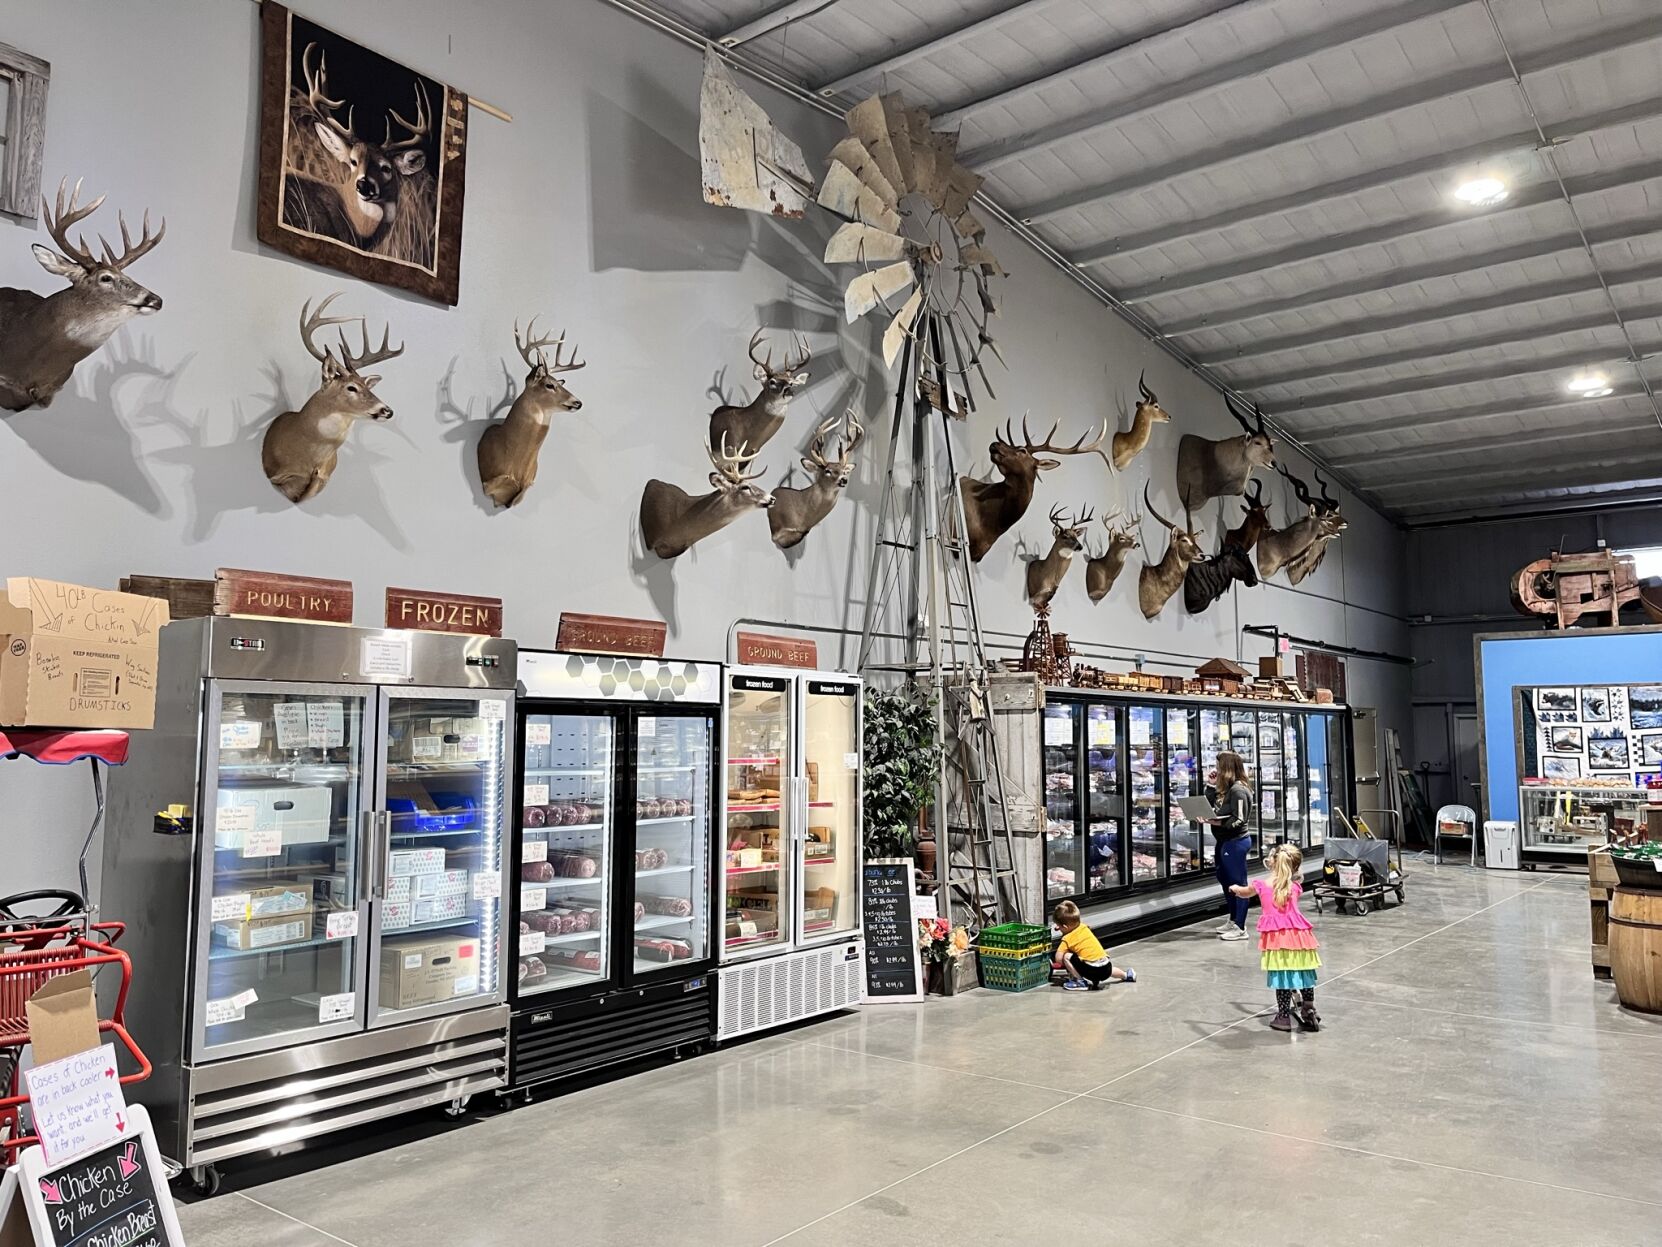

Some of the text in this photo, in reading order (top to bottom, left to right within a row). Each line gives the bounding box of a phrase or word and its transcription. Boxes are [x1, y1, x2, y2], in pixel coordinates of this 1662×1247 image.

[92, 592, 125, 614] Cases
[247, 590, 332, 612] POULTRY
[401, 601, 490, 628] FROZEN
[625, 634, 655, 648] BEEF
[747, 646, 809, 662] GROUND BEEF
[746, 680, 774, 689] frozen food
[69, 697, 131, 712] DRUMSTICKS
[32, 1056, 106, 1090] Cases of Chicken
[38, 1072, 101, 1106] are in back cooler
[42, 1112, 54, 1128] Let
[57, 1112, 66, 1120] us
[85, 1091, 100, 1108] what
[102, 1091, 114, 1105] you
[47, 1125, 64, 1139] want
[68, 1116, 82, 1130] and
[102, 1105, 111, 1119] get
[60, 1139, 69, 1150] for
[72, 1135, 85, 1150] you
[58, 1166, 116, 1202] Chicken
[56, 1182, 132, 1237] By the Case
[127, 1200, 156, 1238] Breast
